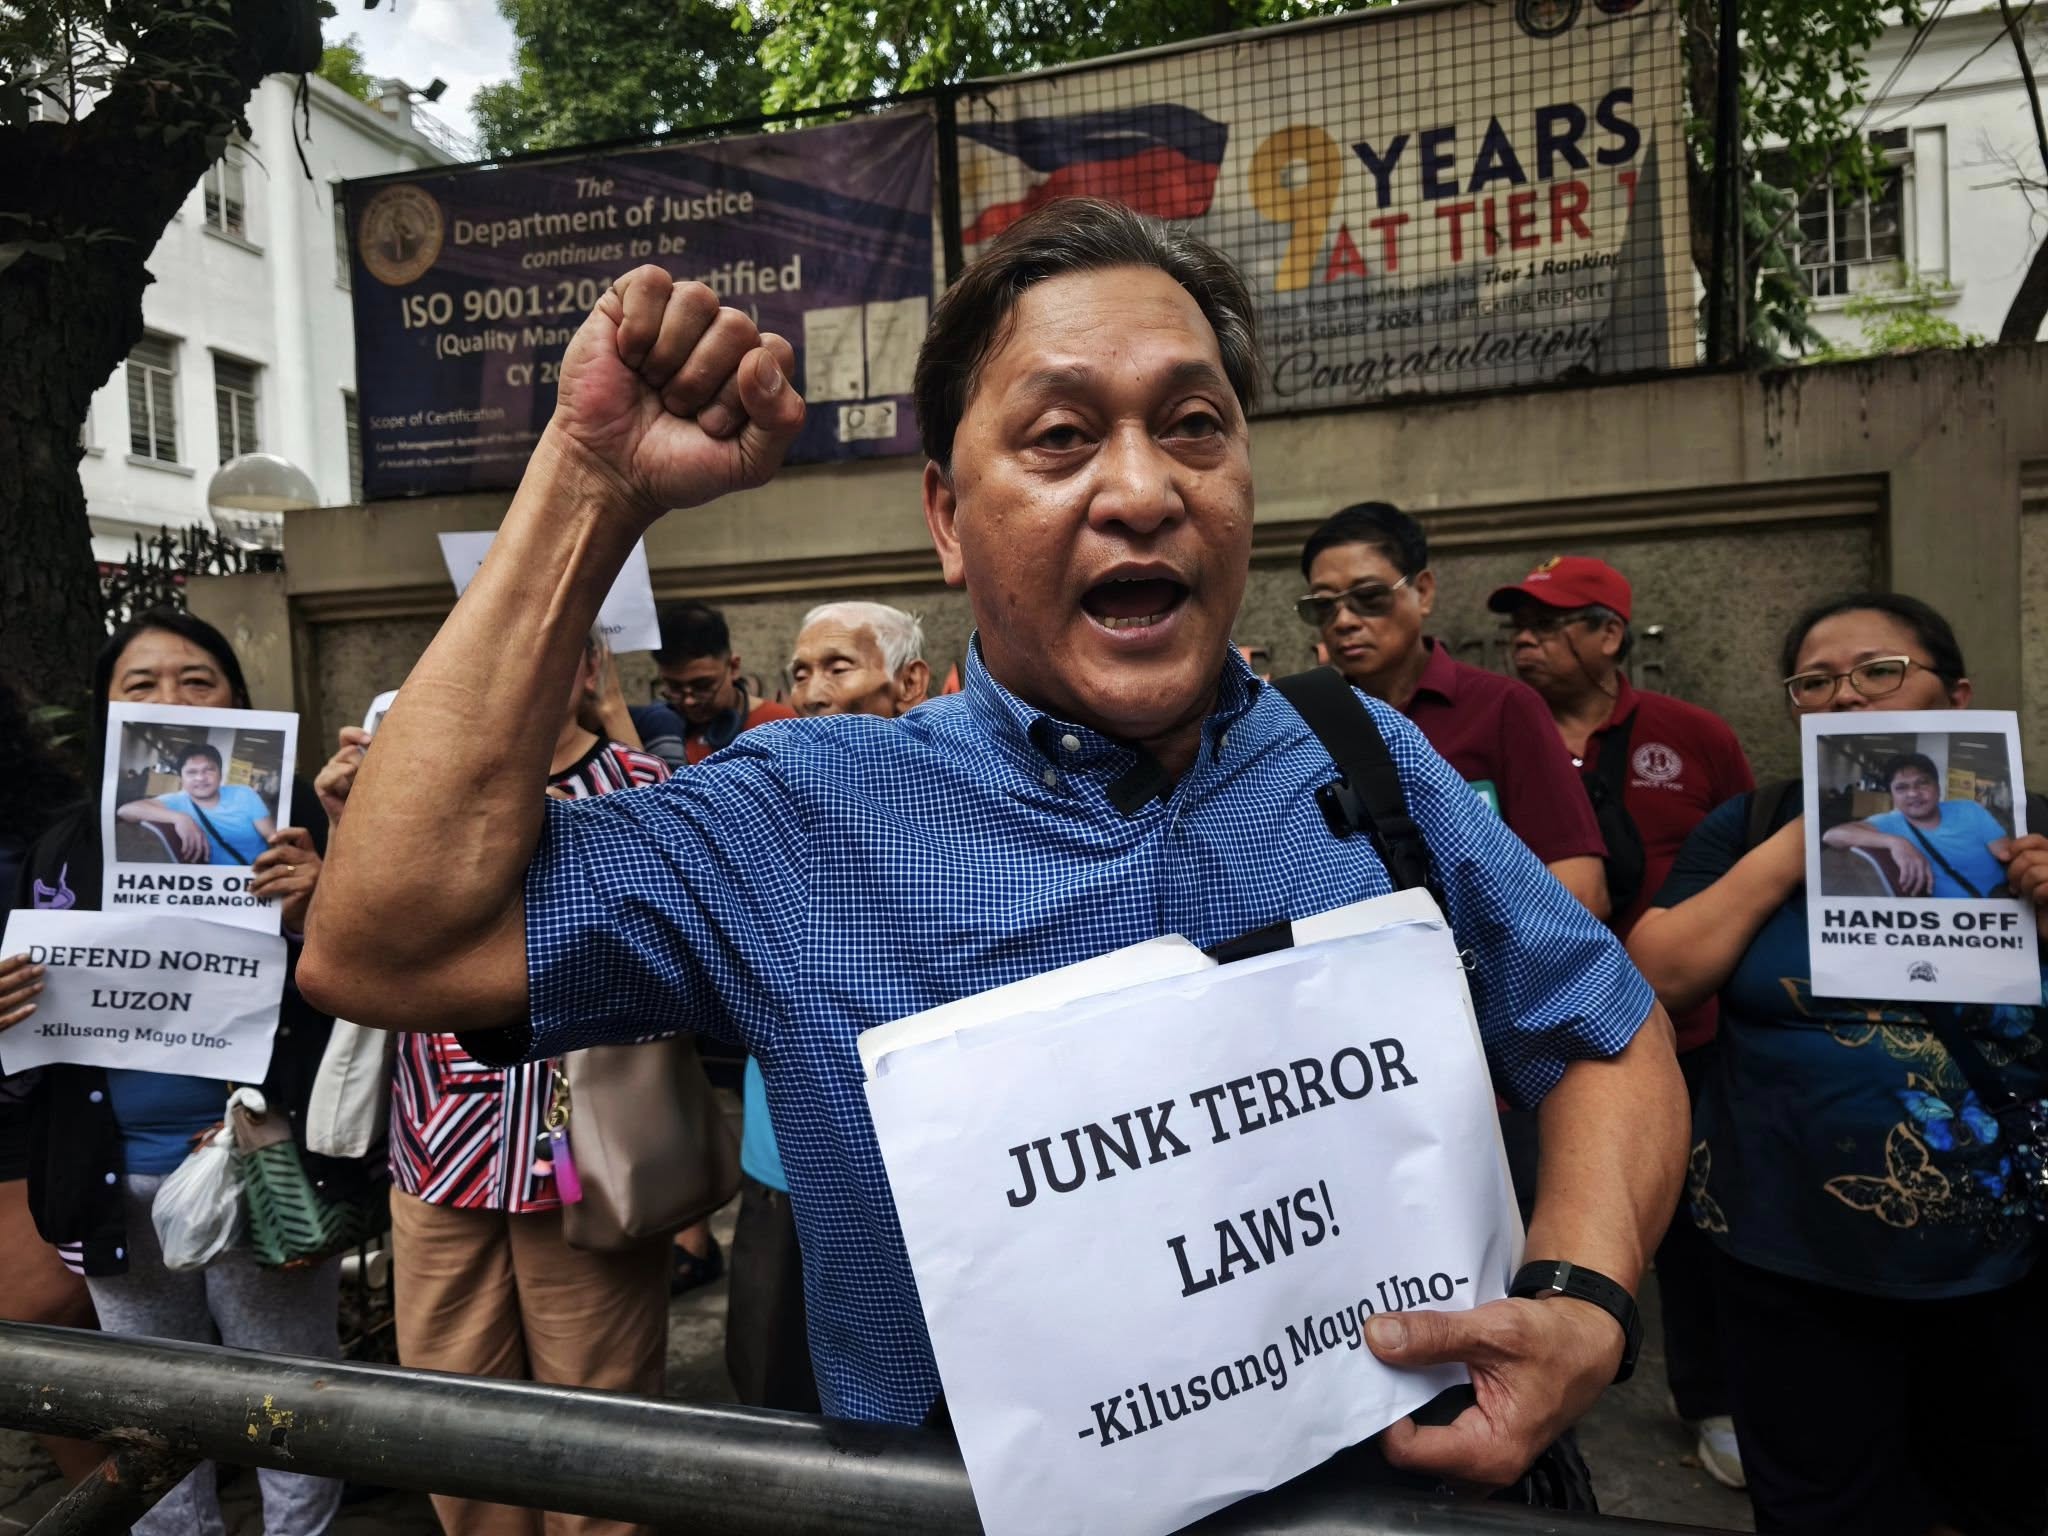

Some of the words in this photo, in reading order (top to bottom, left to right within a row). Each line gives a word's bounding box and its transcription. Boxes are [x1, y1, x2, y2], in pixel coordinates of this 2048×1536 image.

[575, 177, 614, 198] The
[1248, 124, 1341, 292] 9
[1352, 87, 1641, 209] YEARS
[454, 205, 618, 247] Department
[625, 196, 655, 227] of
[661, 190, 754, 223] Justice
[1324, 214, 1409, 283] AT
[1435, 179, 1592, 262] TIER
[522, 243, 624, 270] continues
[630, 238, 652, 258] to
[659, 233, 686, 254] be
[1485, 267, 1522, 286] Tier
[401, 292, 454, 329] ISO
[1376, 307, 1425, 332] 2024
[436, 329, 517, 360] (Quality
[506, 362, 535, 387] CY
[369, 414, 406, 430] Scope
[409, 411, 423, 426] of
[426, 407, 505, 425] Certification
[117, 874, 213, 892] HANDS
[113, 893, 160, 905] MIKE
[166, 893, 273, 908] CABANGON!
[1823, 909, 1941, 930] HANDS
[1952, 912, 2019, 931] OFF
[1821, 931, 1877, 945] MIKE
[1885, 933, 2024, 949] CABANGON!
[29, 945, 151, 970] DEFEND
[158, 950, 261, 978] NORTH
[91, 989, 192, 1012] LUZON
[34, 1023, 130, 1043] -Kilusang
[135, 1027, 187, 1047] Mayo
[191, 1032, 233, 1050] Uno-
[1006, 1099, 1191, 1208] JUNK
[1191, 1037, 1418, 1145] TERROR
[1167, 1179, 1341, 1298] LAWS!
[1077, 1342, 1290, 1448] -Kilusang
[1285, 1298, 1376, 1367] Mayo
[1376, 1272, 1469, 1313] Uno-
